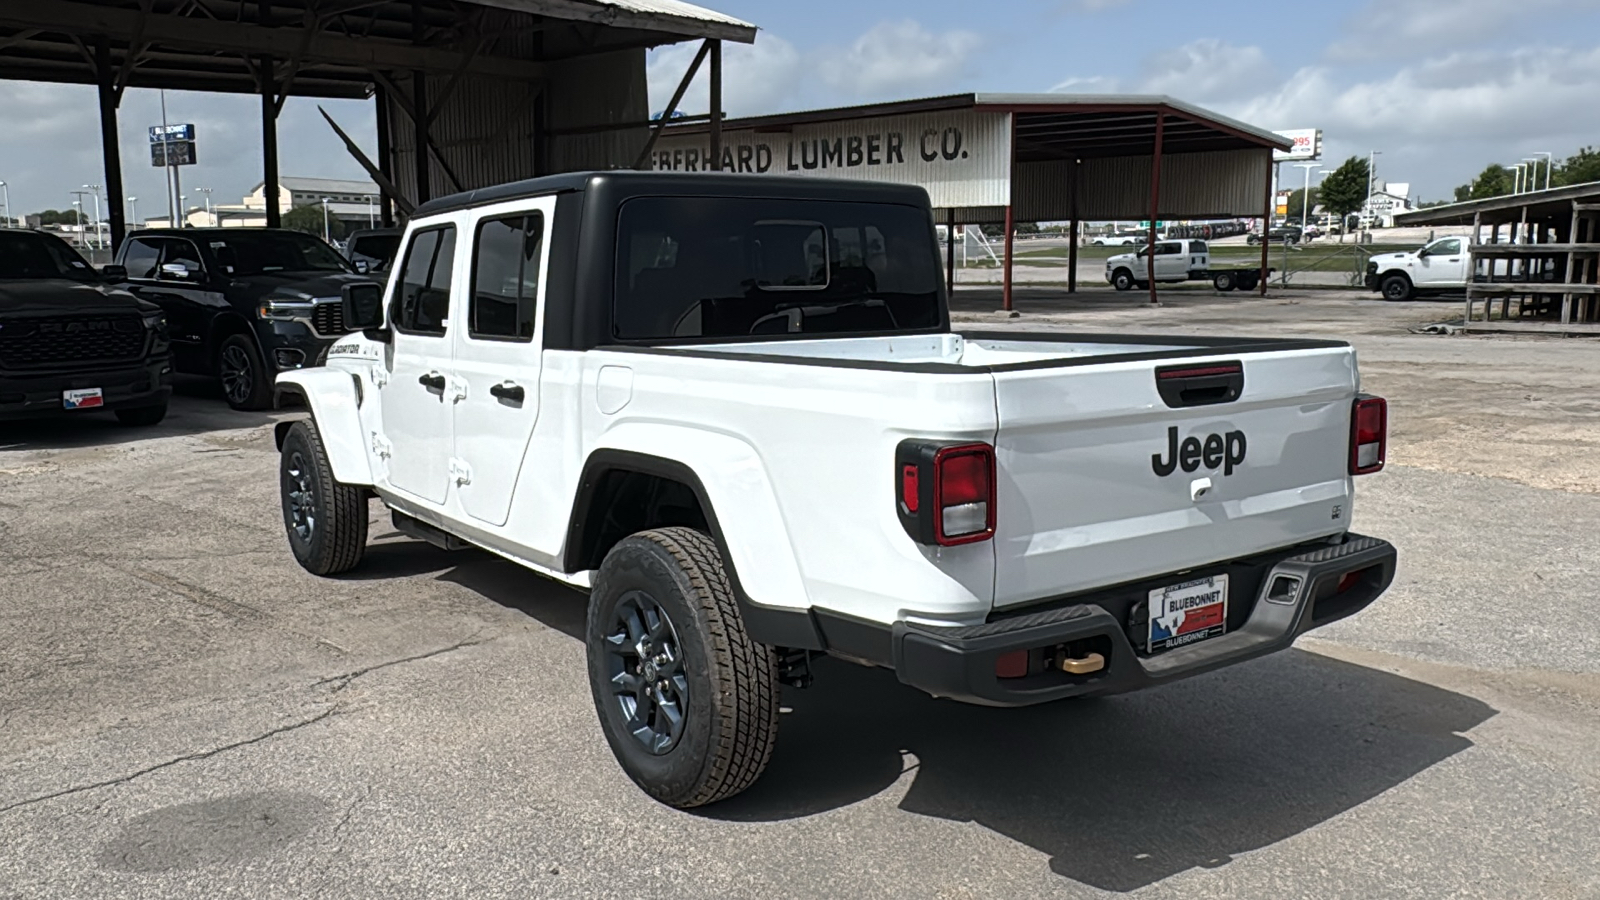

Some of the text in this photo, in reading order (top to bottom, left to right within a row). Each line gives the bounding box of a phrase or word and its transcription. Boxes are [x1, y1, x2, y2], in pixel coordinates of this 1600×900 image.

[787, 131, 904, 171] LUMBER
[920, 127, 968, 162] CO.
[1152, 426, 1247, 477] Jeep
[1169, 590, 1220, 613] BLUEBONNET
[1165, 629, 1209, 648] BLUEBONNET
